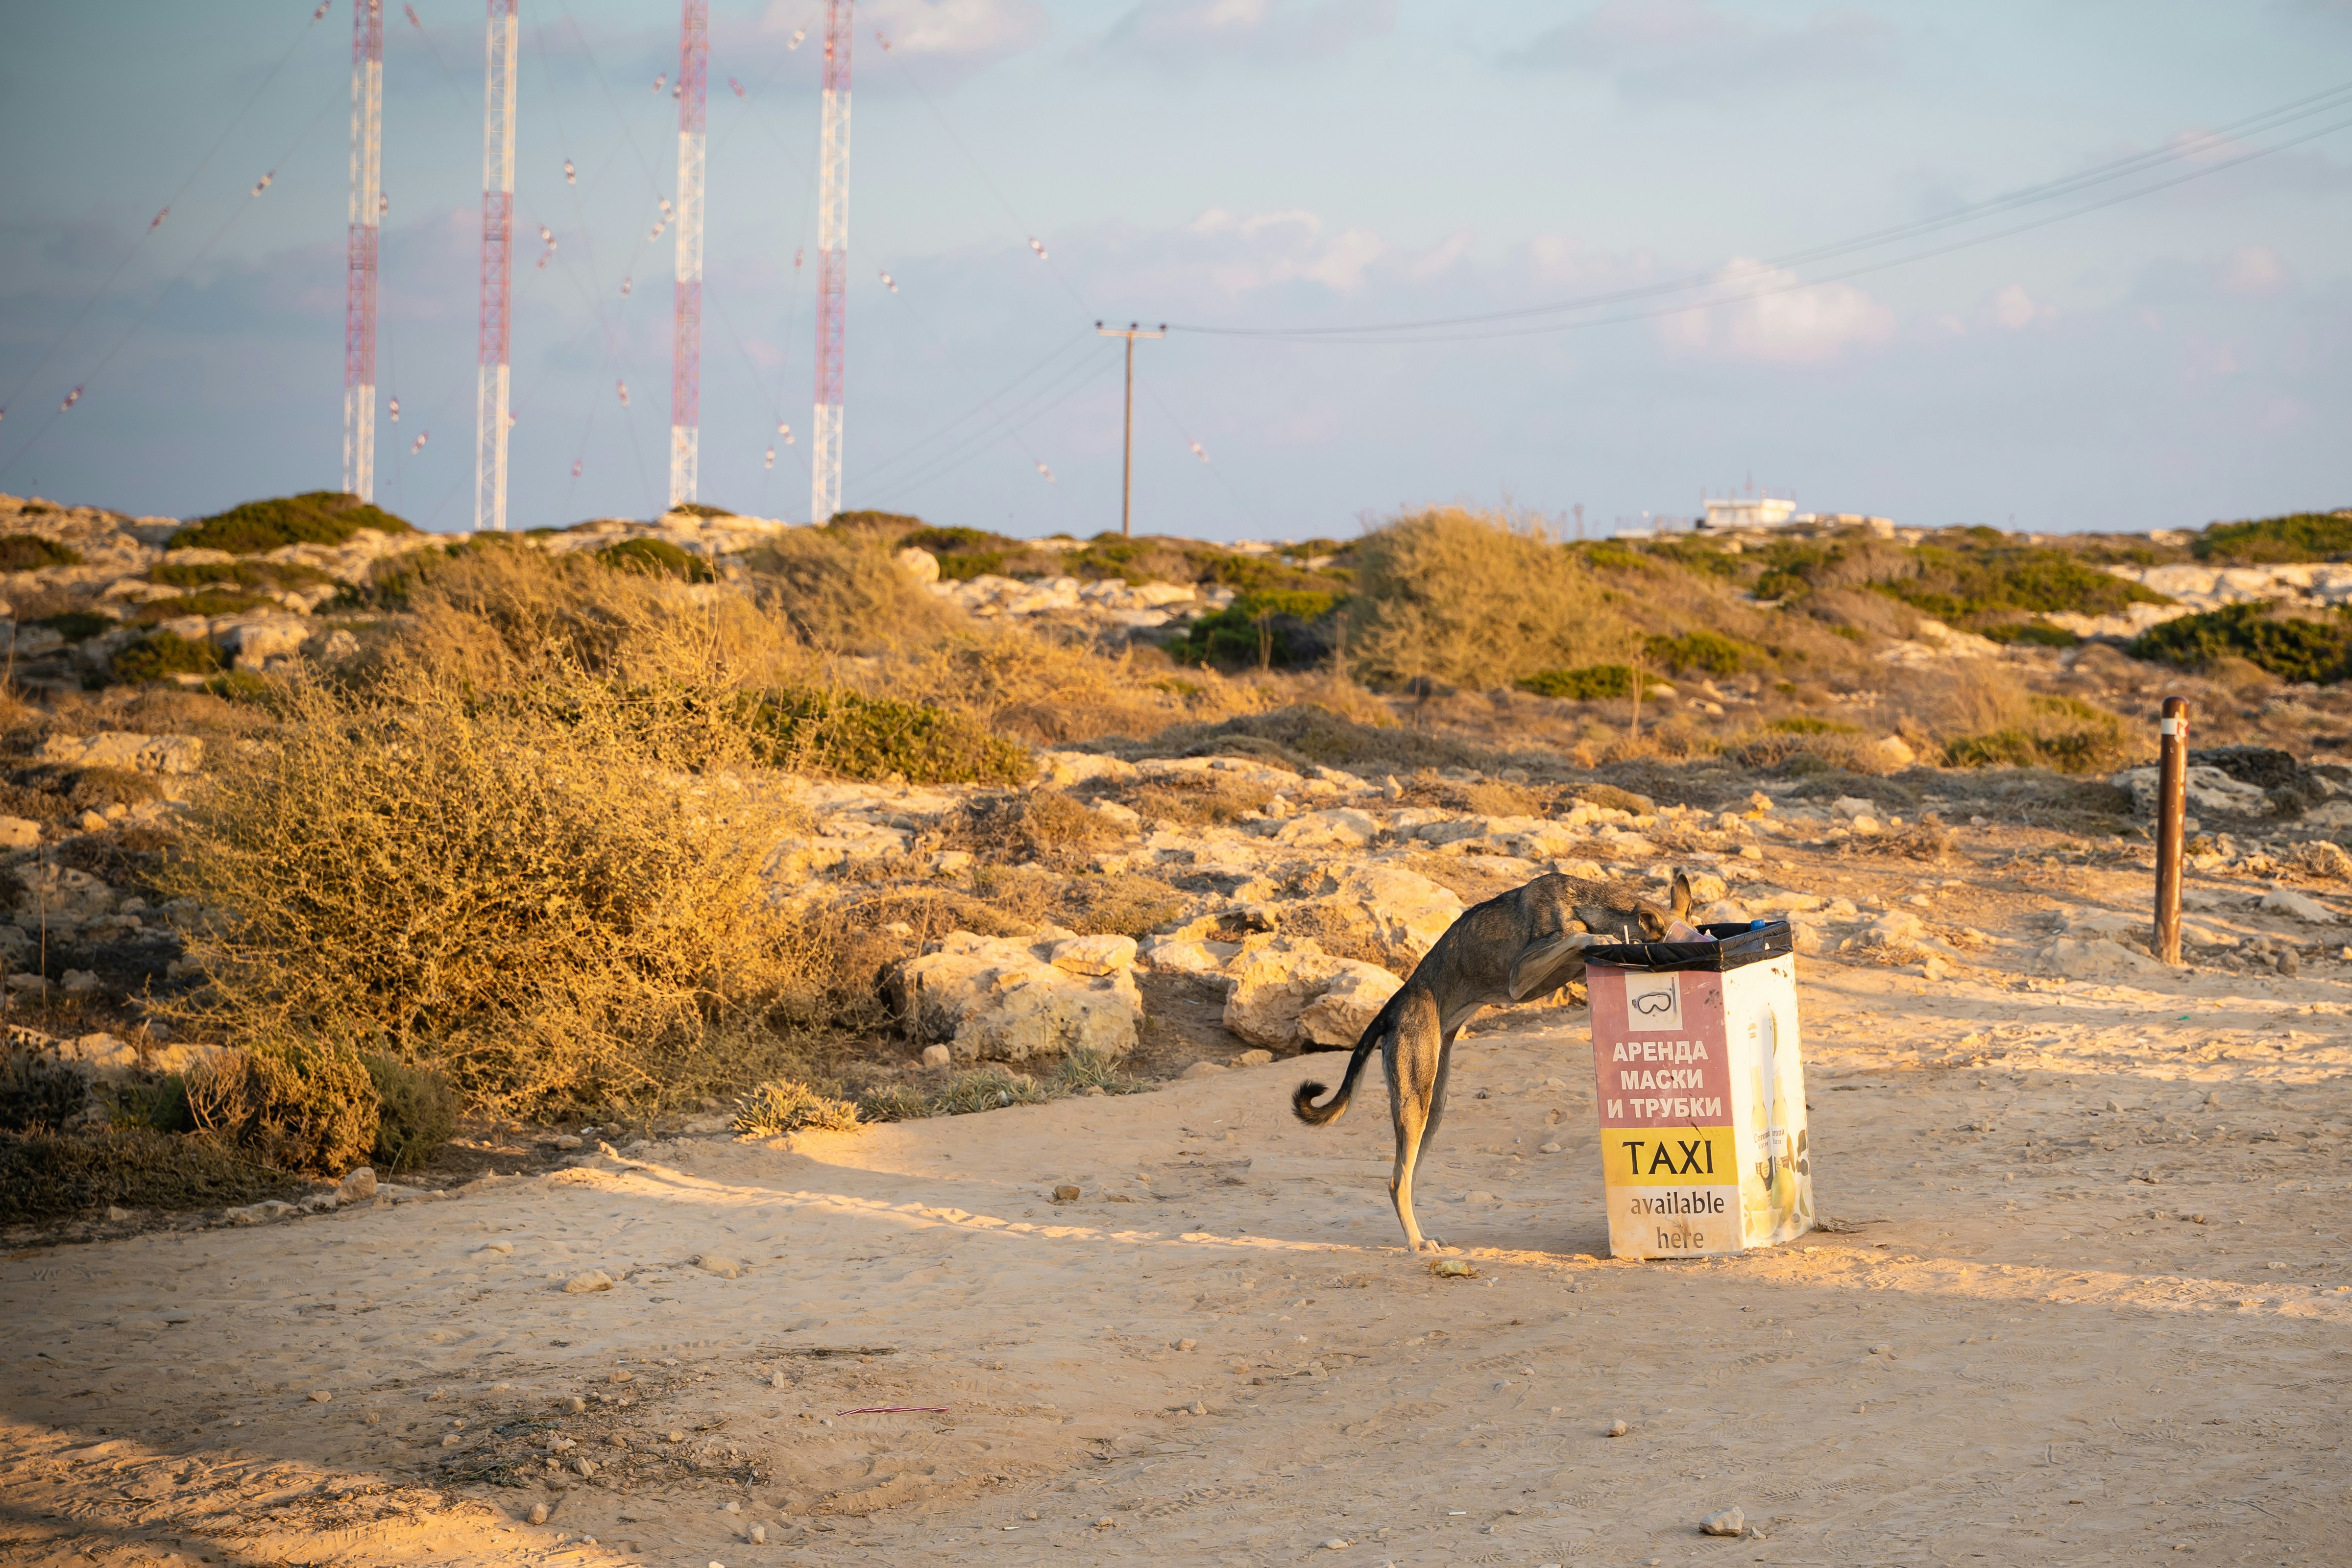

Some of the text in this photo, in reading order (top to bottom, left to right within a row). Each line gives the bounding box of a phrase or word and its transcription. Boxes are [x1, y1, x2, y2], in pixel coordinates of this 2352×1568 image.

[1612, 1040, 1709, 1064] АРЕНДА
[1621, 1068, 1703, 1090] МАСКИ
[1607, 1097, 1722, 1118] И ТРУБКИ
[1622, 1140, 1714, 1175] TAXI
[1630, 1191, 1724, 1214] available
[1656, 1226, 1704, 1249] here
